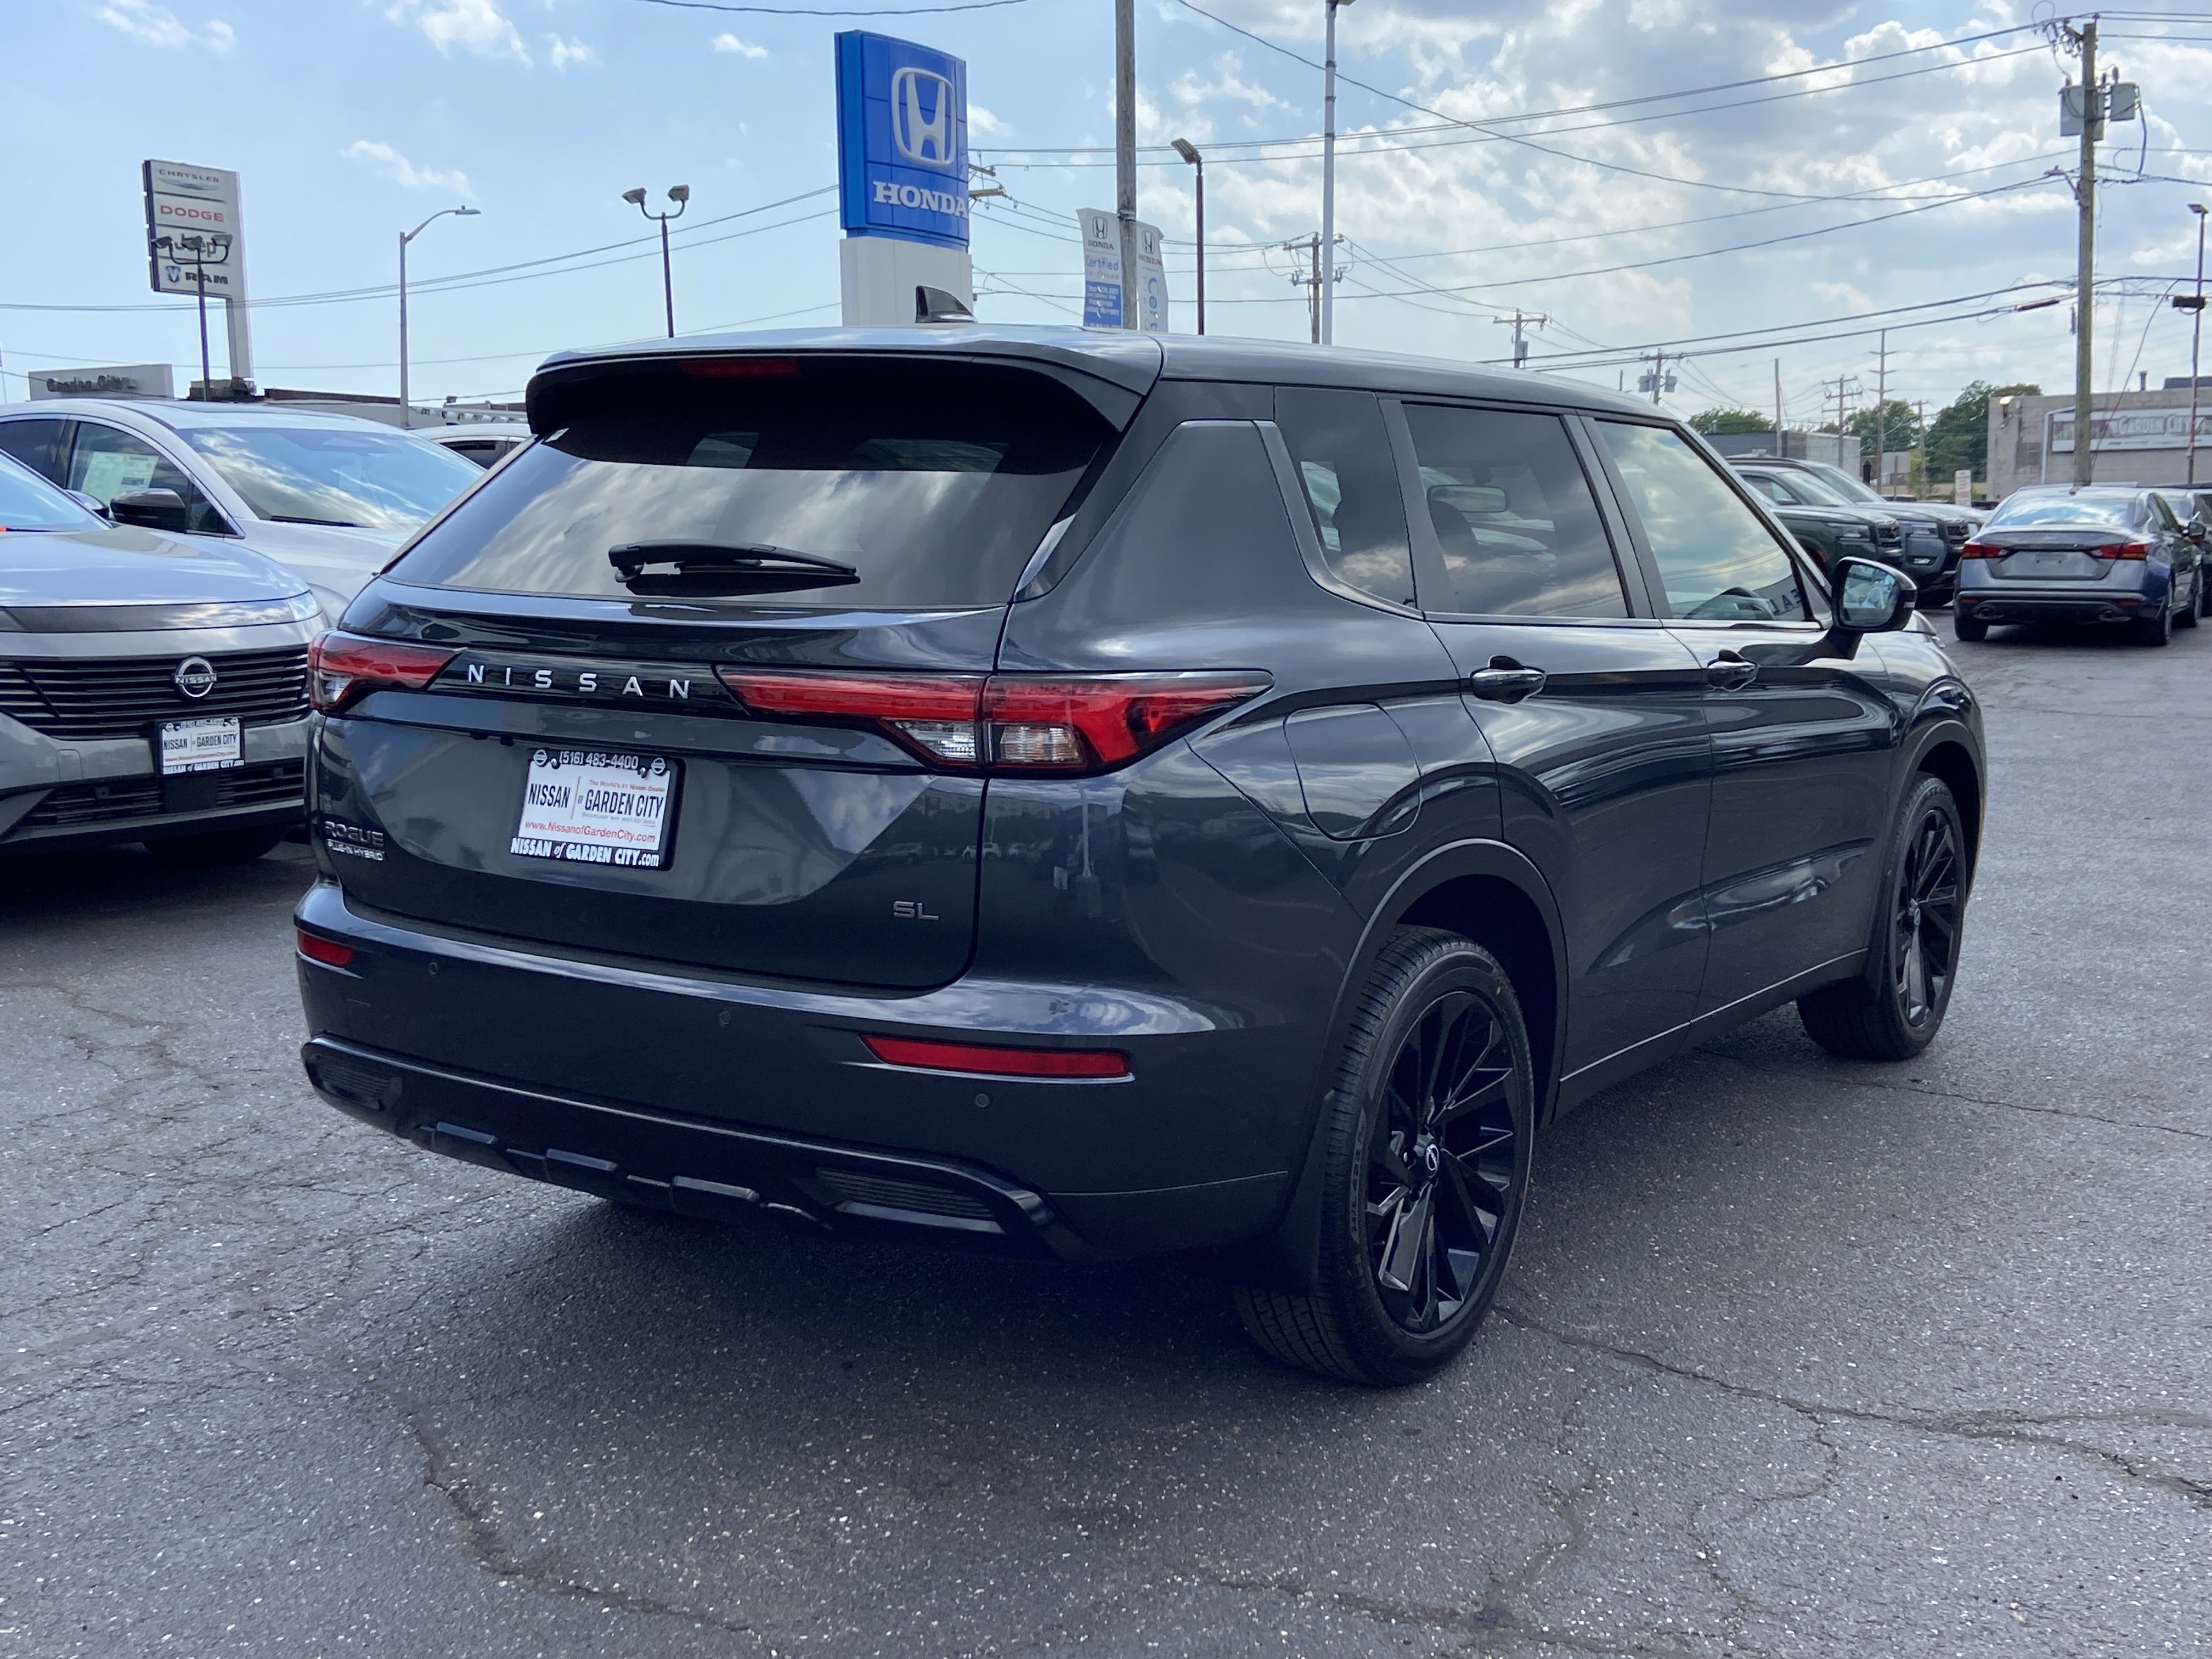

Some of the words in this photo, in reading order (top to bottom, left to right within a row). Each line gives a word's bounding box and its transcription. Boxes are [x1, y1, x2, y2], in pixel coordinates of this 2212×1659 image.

[159, 169, 219, 183] CHRYSLER
[873, 180, 969, 219] HONDA
[160, 205, 224, 222] DODGE
[1088, 239, 1115, 251] HONDA
[185, 272, 229, 284] RAM
[176, 673, 217, 684] NISSAN
[469, 664, 691, 699] NISSAN
[163, 738, 188, 750] NISSAN
[197, 734, 221, 747] GARDEN
[223, 733, 238, 744] CITY
[559, 751, 583, 765] (516)
[585, 753, 639, 769] 483-4400
[528, 783, 571, 809] NISSAN
[585, 789, 635, 816] GARDEN
[636, 795, 664, 819] CITY
[325, 820, 384, 847] ROGUE
[525, 821, 656, 843] www.NissanofGardenCity.com
[328, 840, 354, 855] PLUG-IN
[354, 848, 384, 861] HYBRID
[510, 837, 551, 857] NISSAN
[554, 842, 566, 859] of
[566, 843, 612, 864] GARDEN
[614, 848, 660, 867] CITY.com
[893, 901, 939, 921] SL
